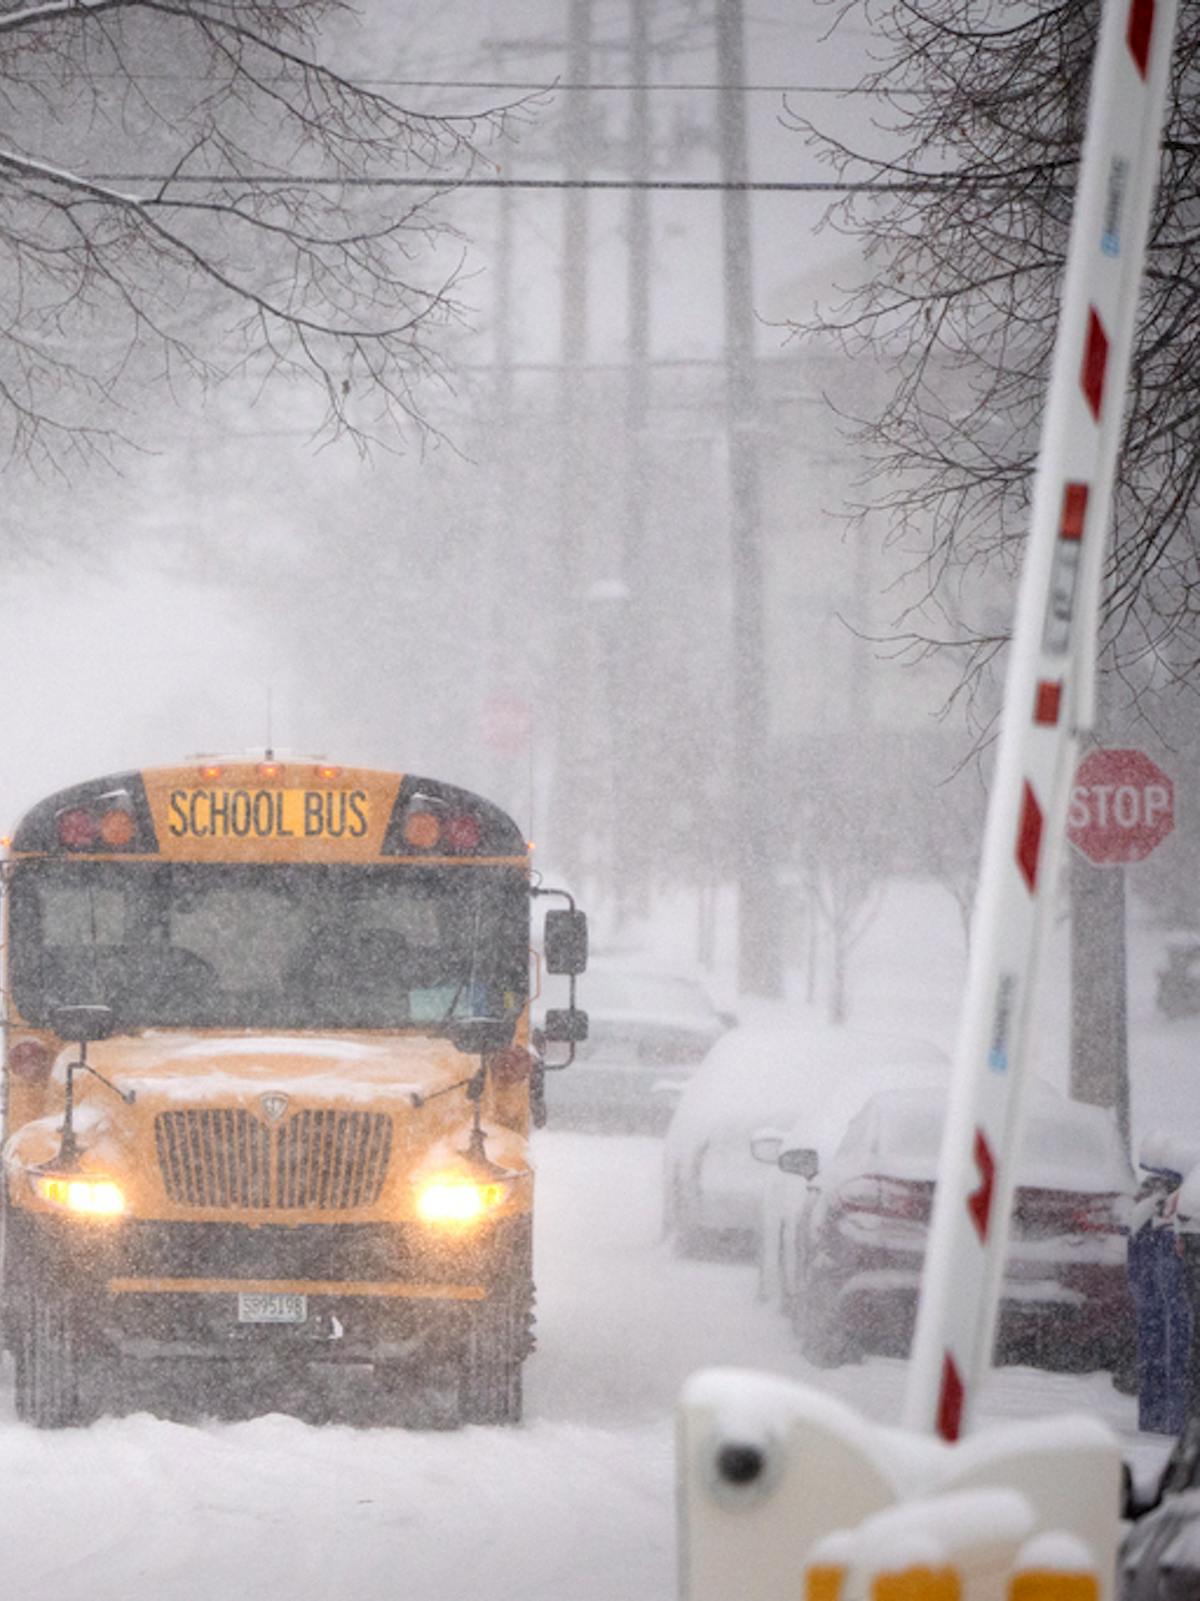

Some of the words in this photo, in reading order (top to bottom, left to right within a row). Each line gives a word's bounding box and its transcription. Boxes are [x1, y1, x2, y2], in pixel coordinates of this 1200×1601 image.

[169, 789, 293, 837] SCHOOL
[304, 789, 368, 837] BUS
[1069, 785, 1169, 828] STOP
